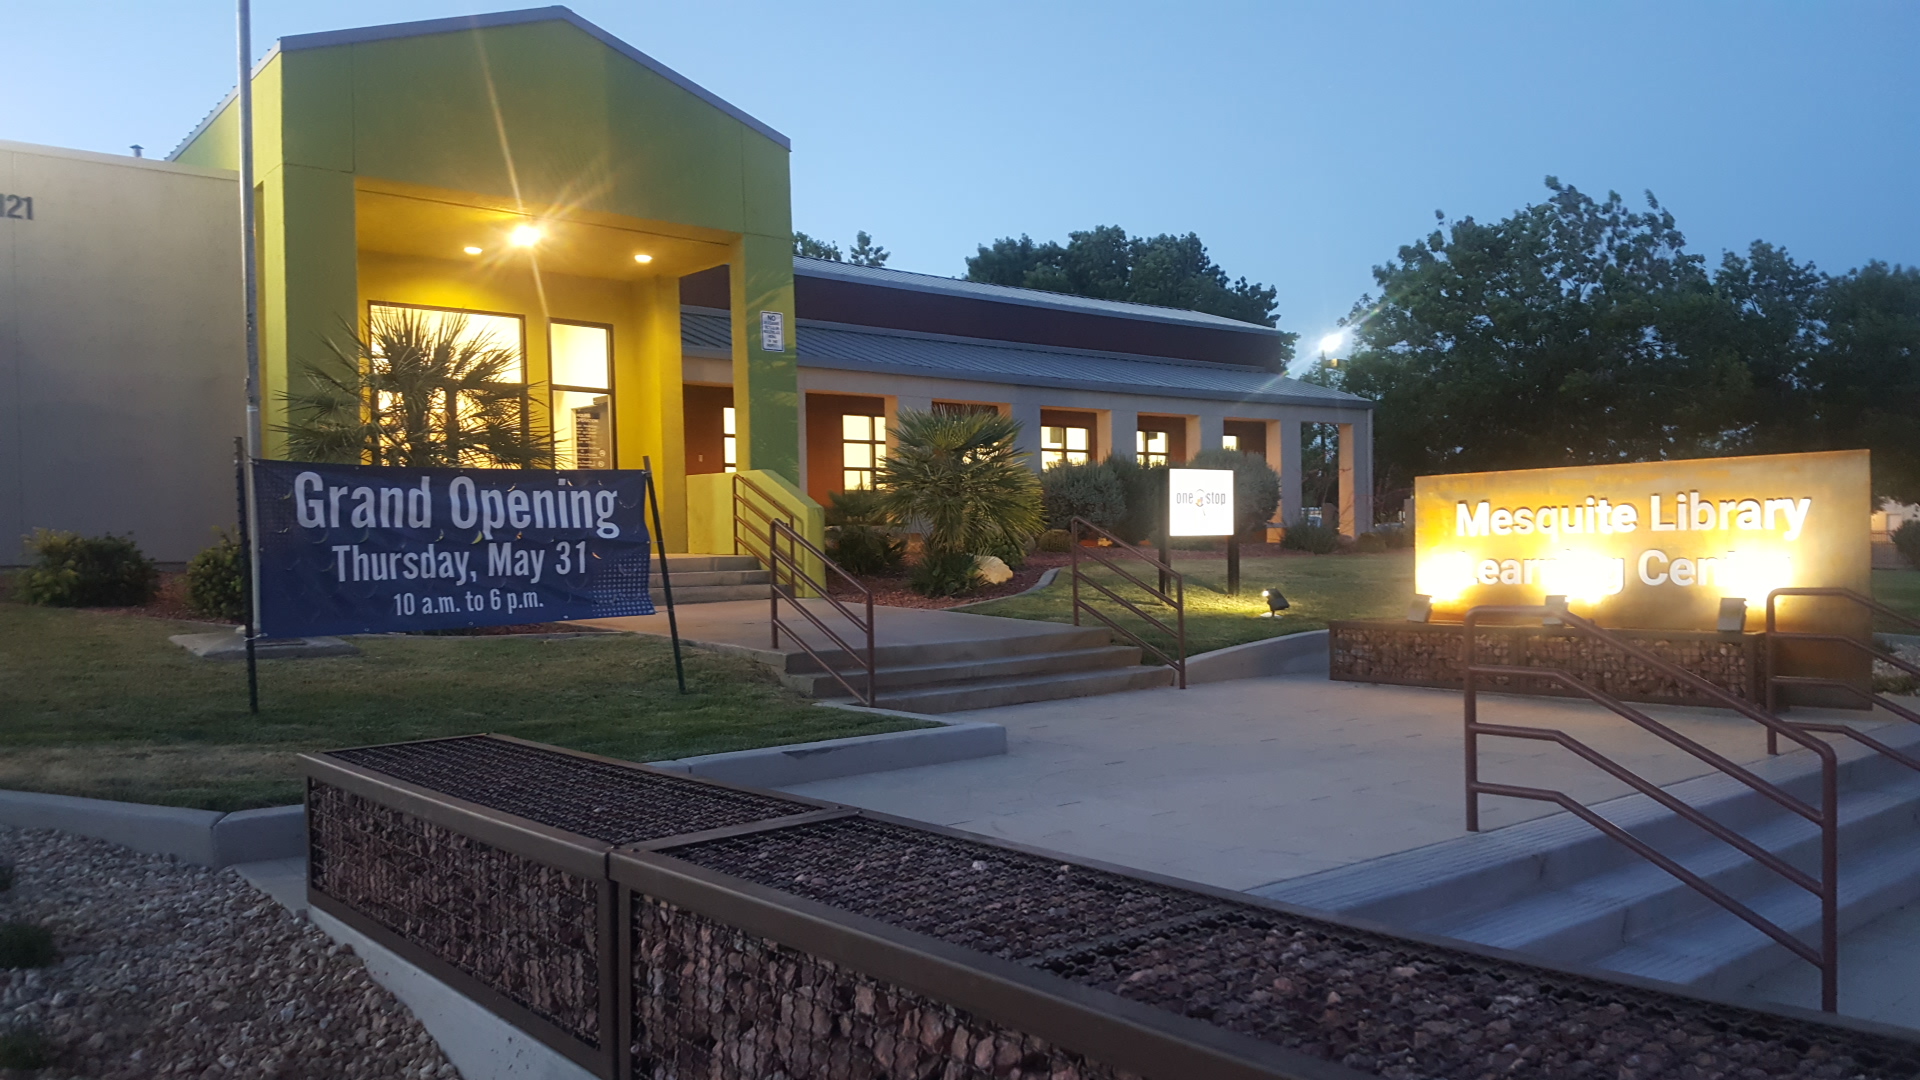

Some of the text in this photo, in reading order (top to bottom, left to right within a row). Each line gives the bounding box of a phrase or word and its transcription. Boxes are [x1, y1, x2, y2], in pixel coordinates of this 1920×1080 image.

[294, 471, 620, 539] Grand Opening
[1176, 491, 1226, 506] one stop
[1455, 490, 1812, 543] Mesquite Library
[332, 540, 587, 586] Thursday, May 31
[393, 589, 544, 616] 10 a.m. to 6 p.m.
